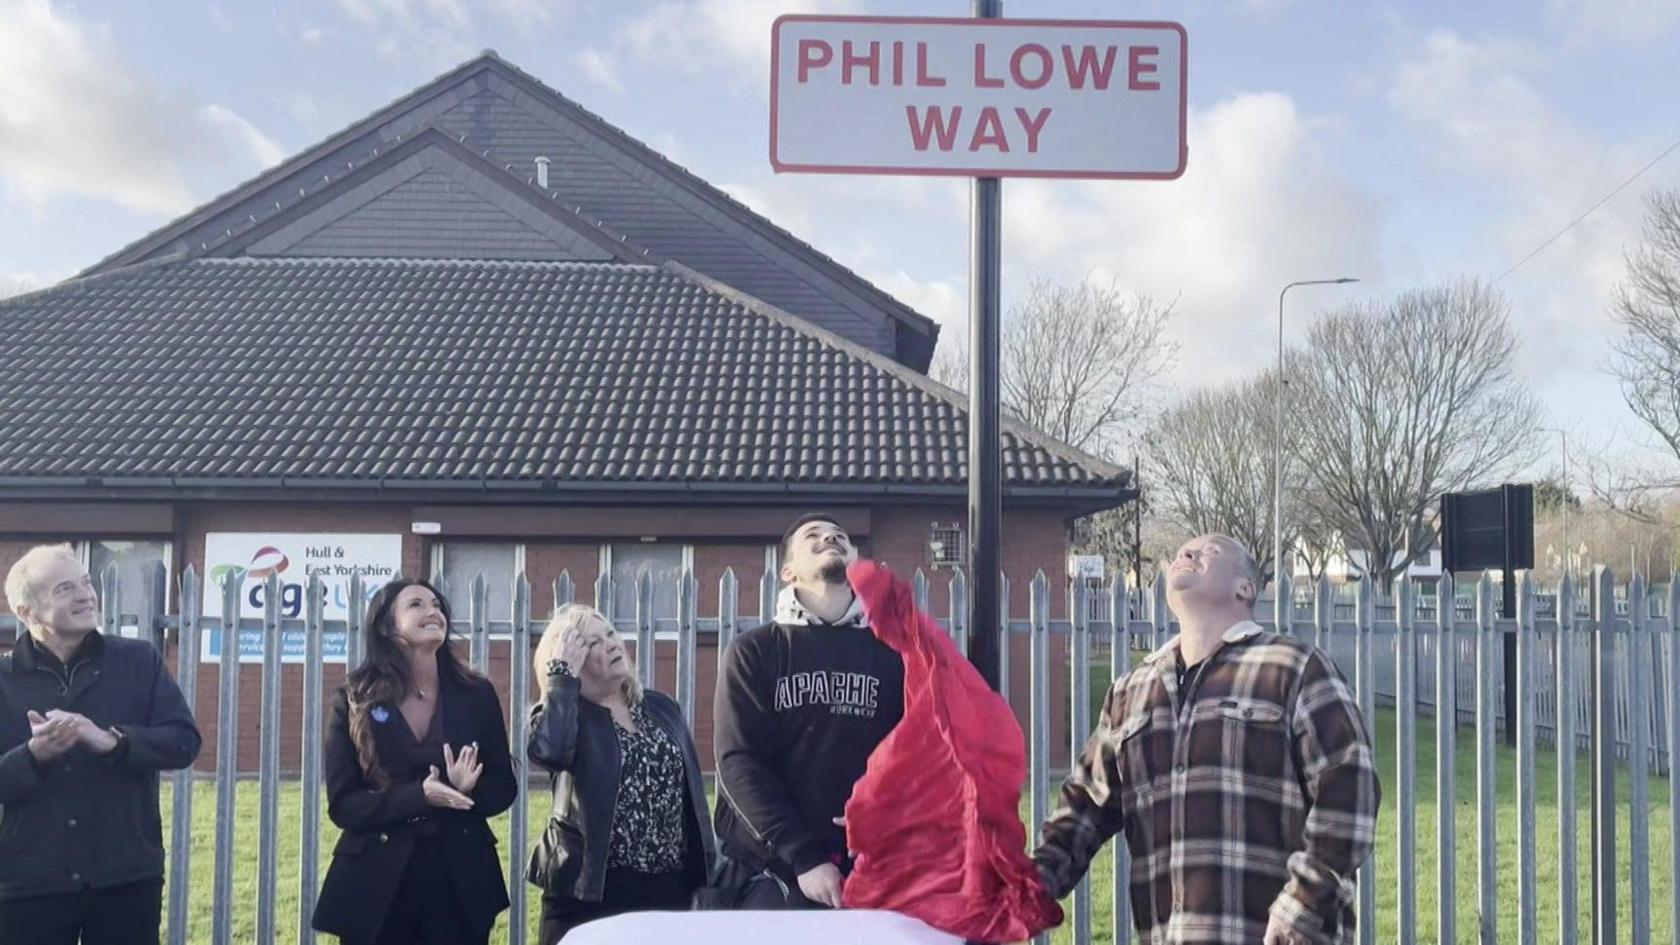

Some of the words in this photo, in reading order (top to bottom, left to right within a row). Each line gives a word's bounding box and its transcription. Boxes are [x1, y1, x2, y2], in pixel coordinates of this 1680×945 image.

[797, 39, 946, 87] PHIL
[974, 43, 1161, 91] LOWE
[906, 105, 1053, 153] WAY
[305, 546, 331, 558] Hull
[334, 546, 345, 558] &
[774, 670, 880, 712] APACHE
